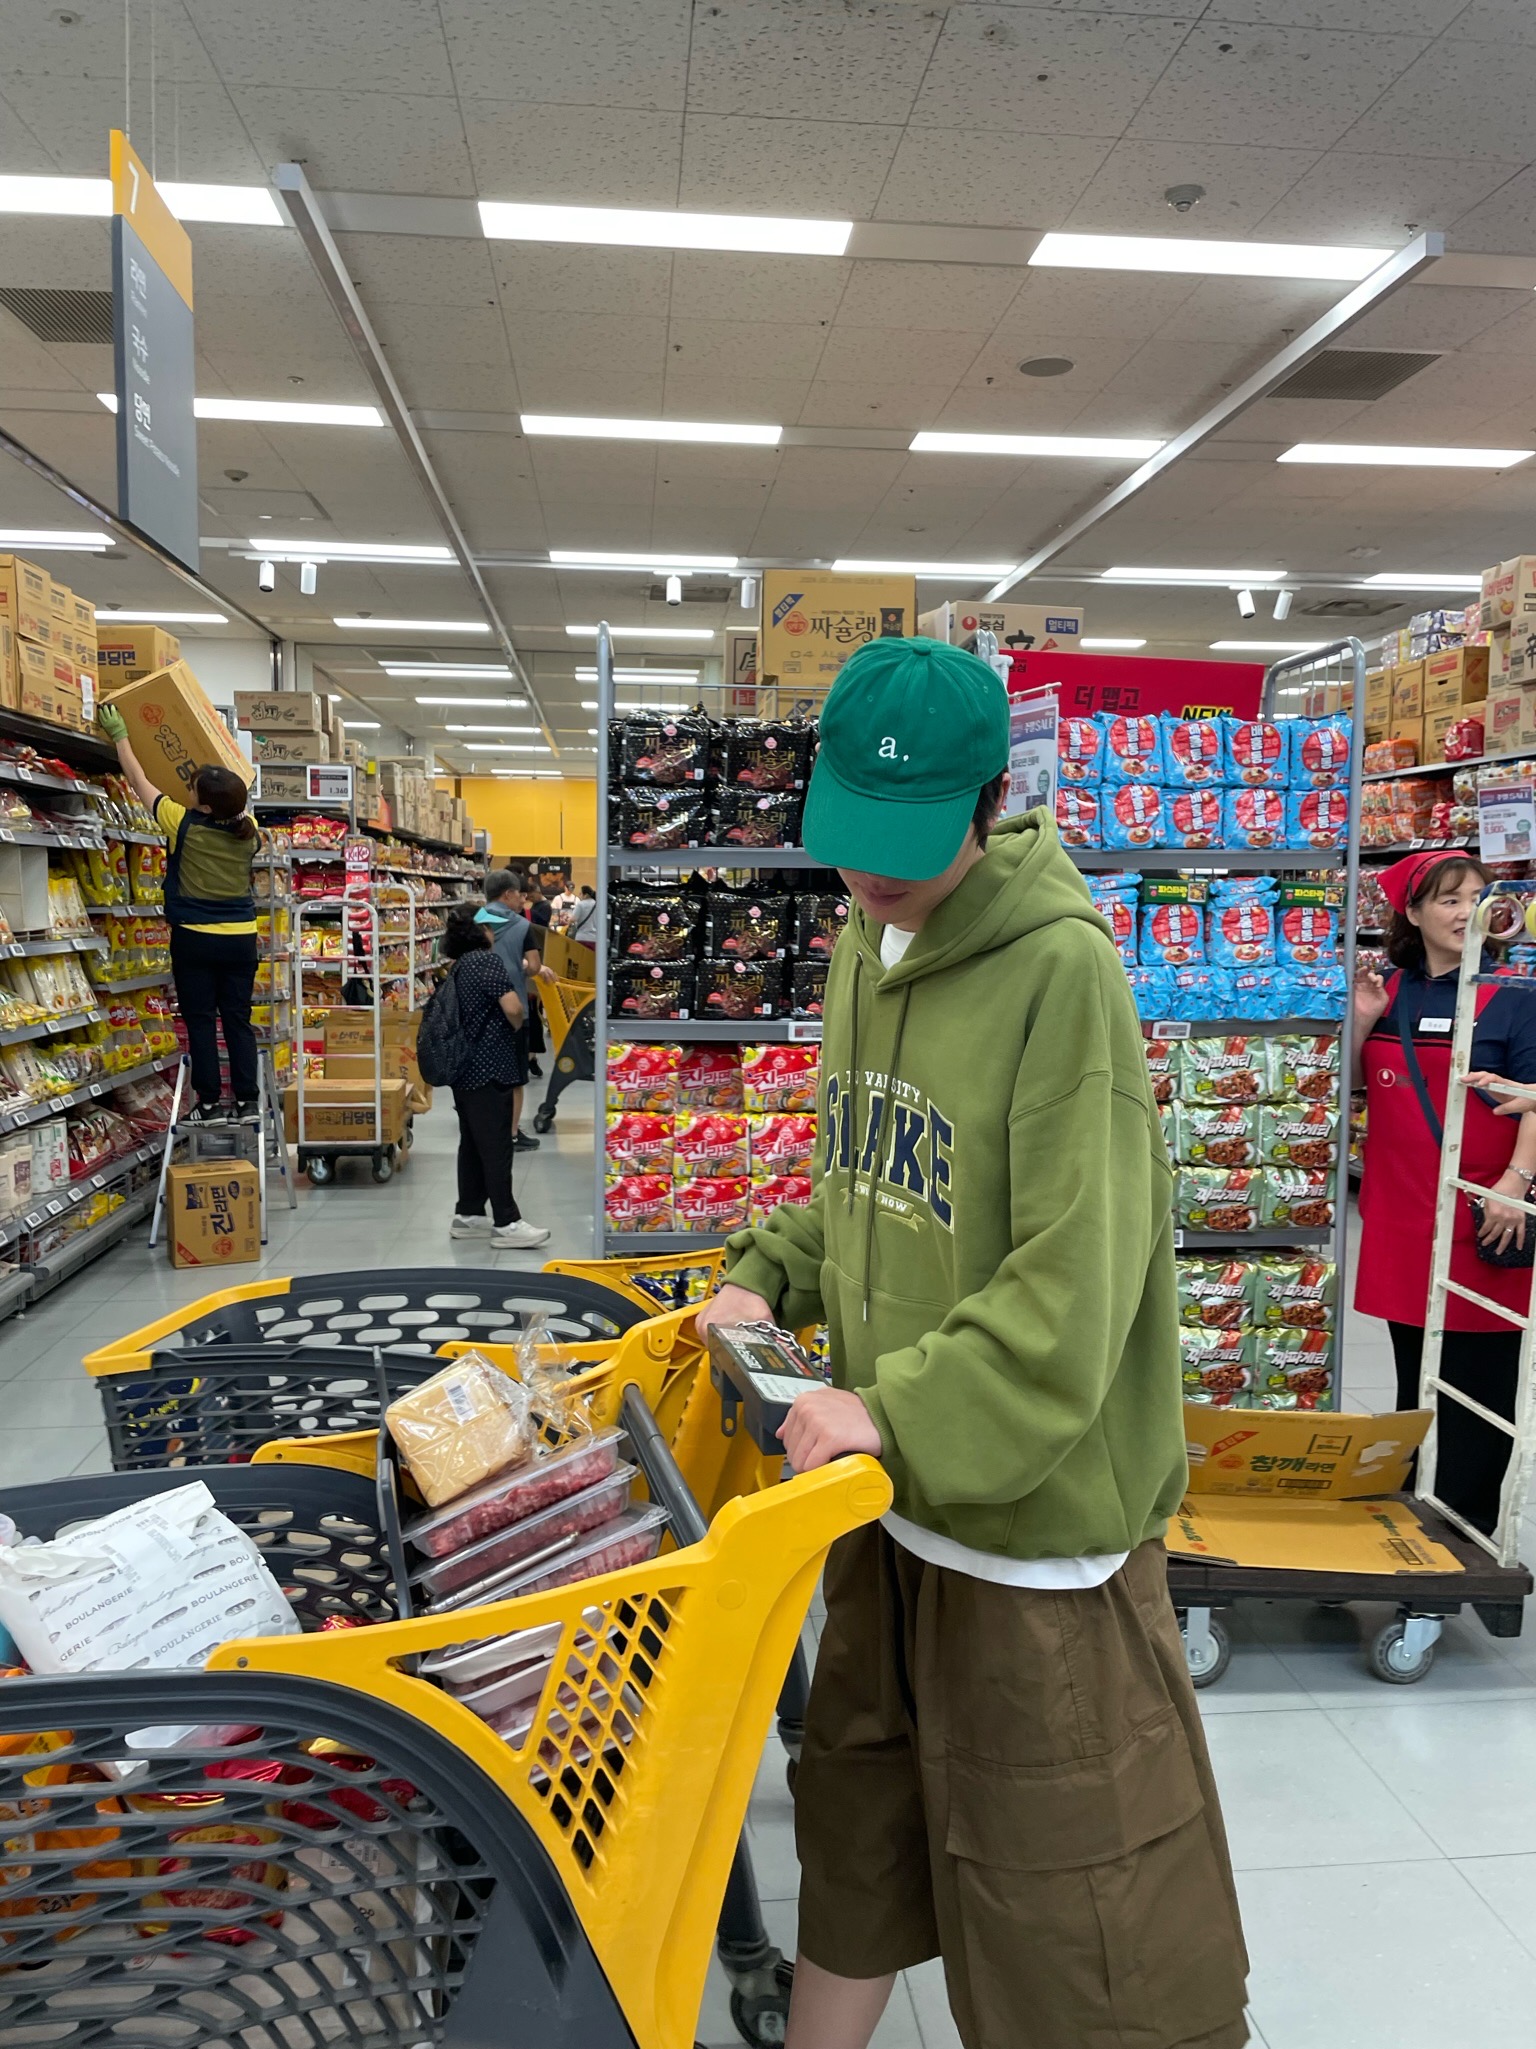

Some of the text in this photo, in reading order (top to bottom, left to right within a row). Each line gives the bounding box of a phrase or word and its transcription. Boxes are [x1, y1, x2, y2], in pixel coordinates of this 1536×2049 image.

[128, 160, 140, 214] 7
[134, 392, 152, 431] 당면
[809, 615, 876, 643] 짜슐랭
[978, 618, 1004, 631] 농심
[1048, 619, 1076, 632] 멀티팩
[1074, 686, 1140, 712] 더 맵고
[746, 750, 796, 770] 짜슐랭
[878, 738, 910, 762] a.
[736, 810, 788, 832] 짜슐랭
[729, 918, 780, 940] 짜슐랭
[631, 978, 682, 999] 짜슐랭
[714, 974, 765, 995] 짜슐랭
[1196, 1054, 1253, 1075] 짜파게티
[1284, 1050, 1333, 1070] 짜파게티
[615, 1070, 668, 1094] 진라면
[680, 1068, 732, 1090] 진라면
[753, 1070, 807, 1095] 진라면
[1191, 1122, 1248, 1140] 짜파게티
[1274, 1121, 1332, 1140] 짜파게티
[608, 1138, 662, 1161] 진라면
[682, 1140, 736, 1164] 진라면
[760, 1139, 812, 1166] 진라면
[881, 1195, 907, 1212] NOW
[1192, 1187, 1252, 1206] 짜파게티
[1276, 1183, 1328, 1202] 짜파게티
[210, 1186, 237, 1236] 진라면
[608, 1198, 663, 1221] 진라면
[682, 1198, 736, 1221] 진라면
[1186, 1278, 1246, 1300] 짜파게티
[1267, 1283, 1326, 1303] 짜파게티
[1184, 1347, 1244, 1367] 짜파게티
[1270, 1350, 1330, 1370] 짜파게티
[1250, 1454, 1337, 1474] 참깨라면
[230, 1554, 250, 1567] BOU
[190, 1573, 260, 1608] BOULANGERIE
[64, 1586, 134, 1630] BOULANGERIE
[154, 1614, 222, 1658] BOULANGERIE
[60, 1636, 93, 1662] GERIE
